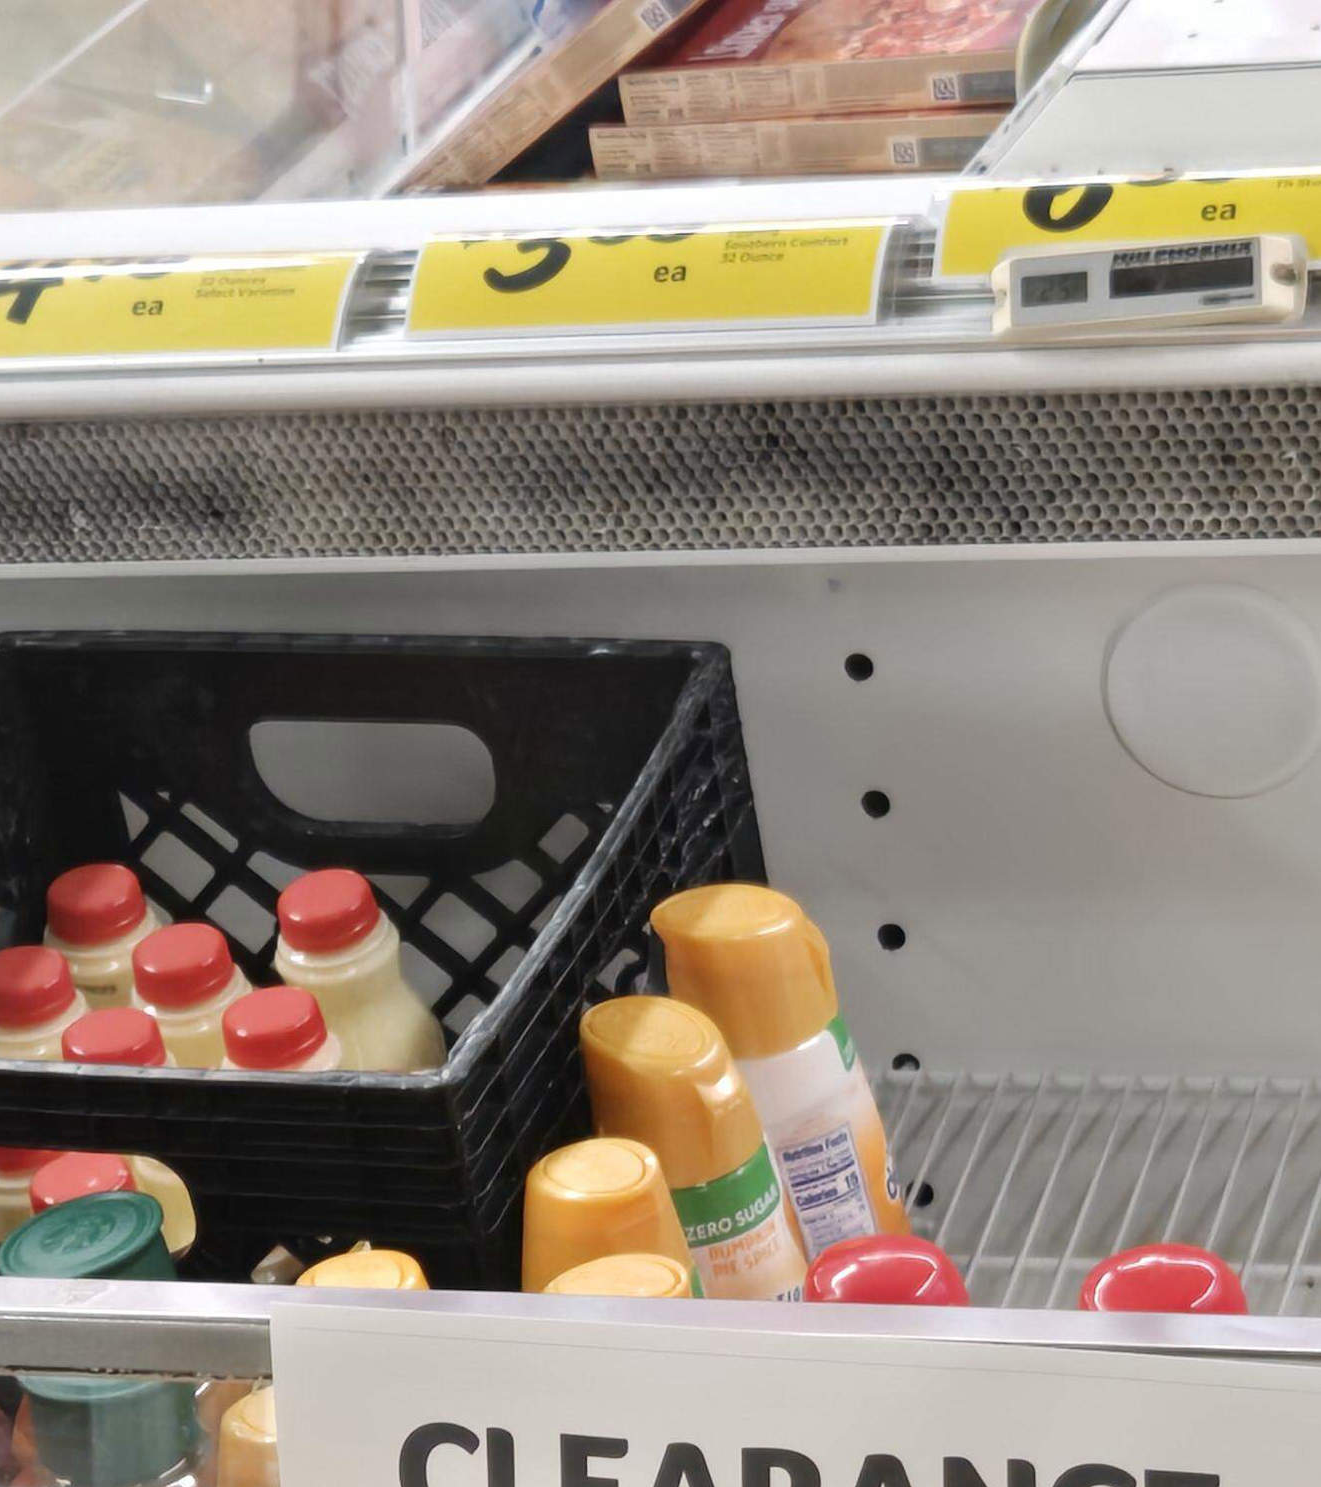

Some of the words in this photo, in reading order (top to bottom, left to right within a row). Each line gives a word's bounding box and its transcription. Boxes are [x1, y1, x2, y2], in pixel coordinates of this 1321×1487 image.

[1201, 202, 1237, 222] ea
[652, 262, 688, 283] ea
[131, 298, 165, 317] ea
[684, 1216, 734, 1242] ZERO
